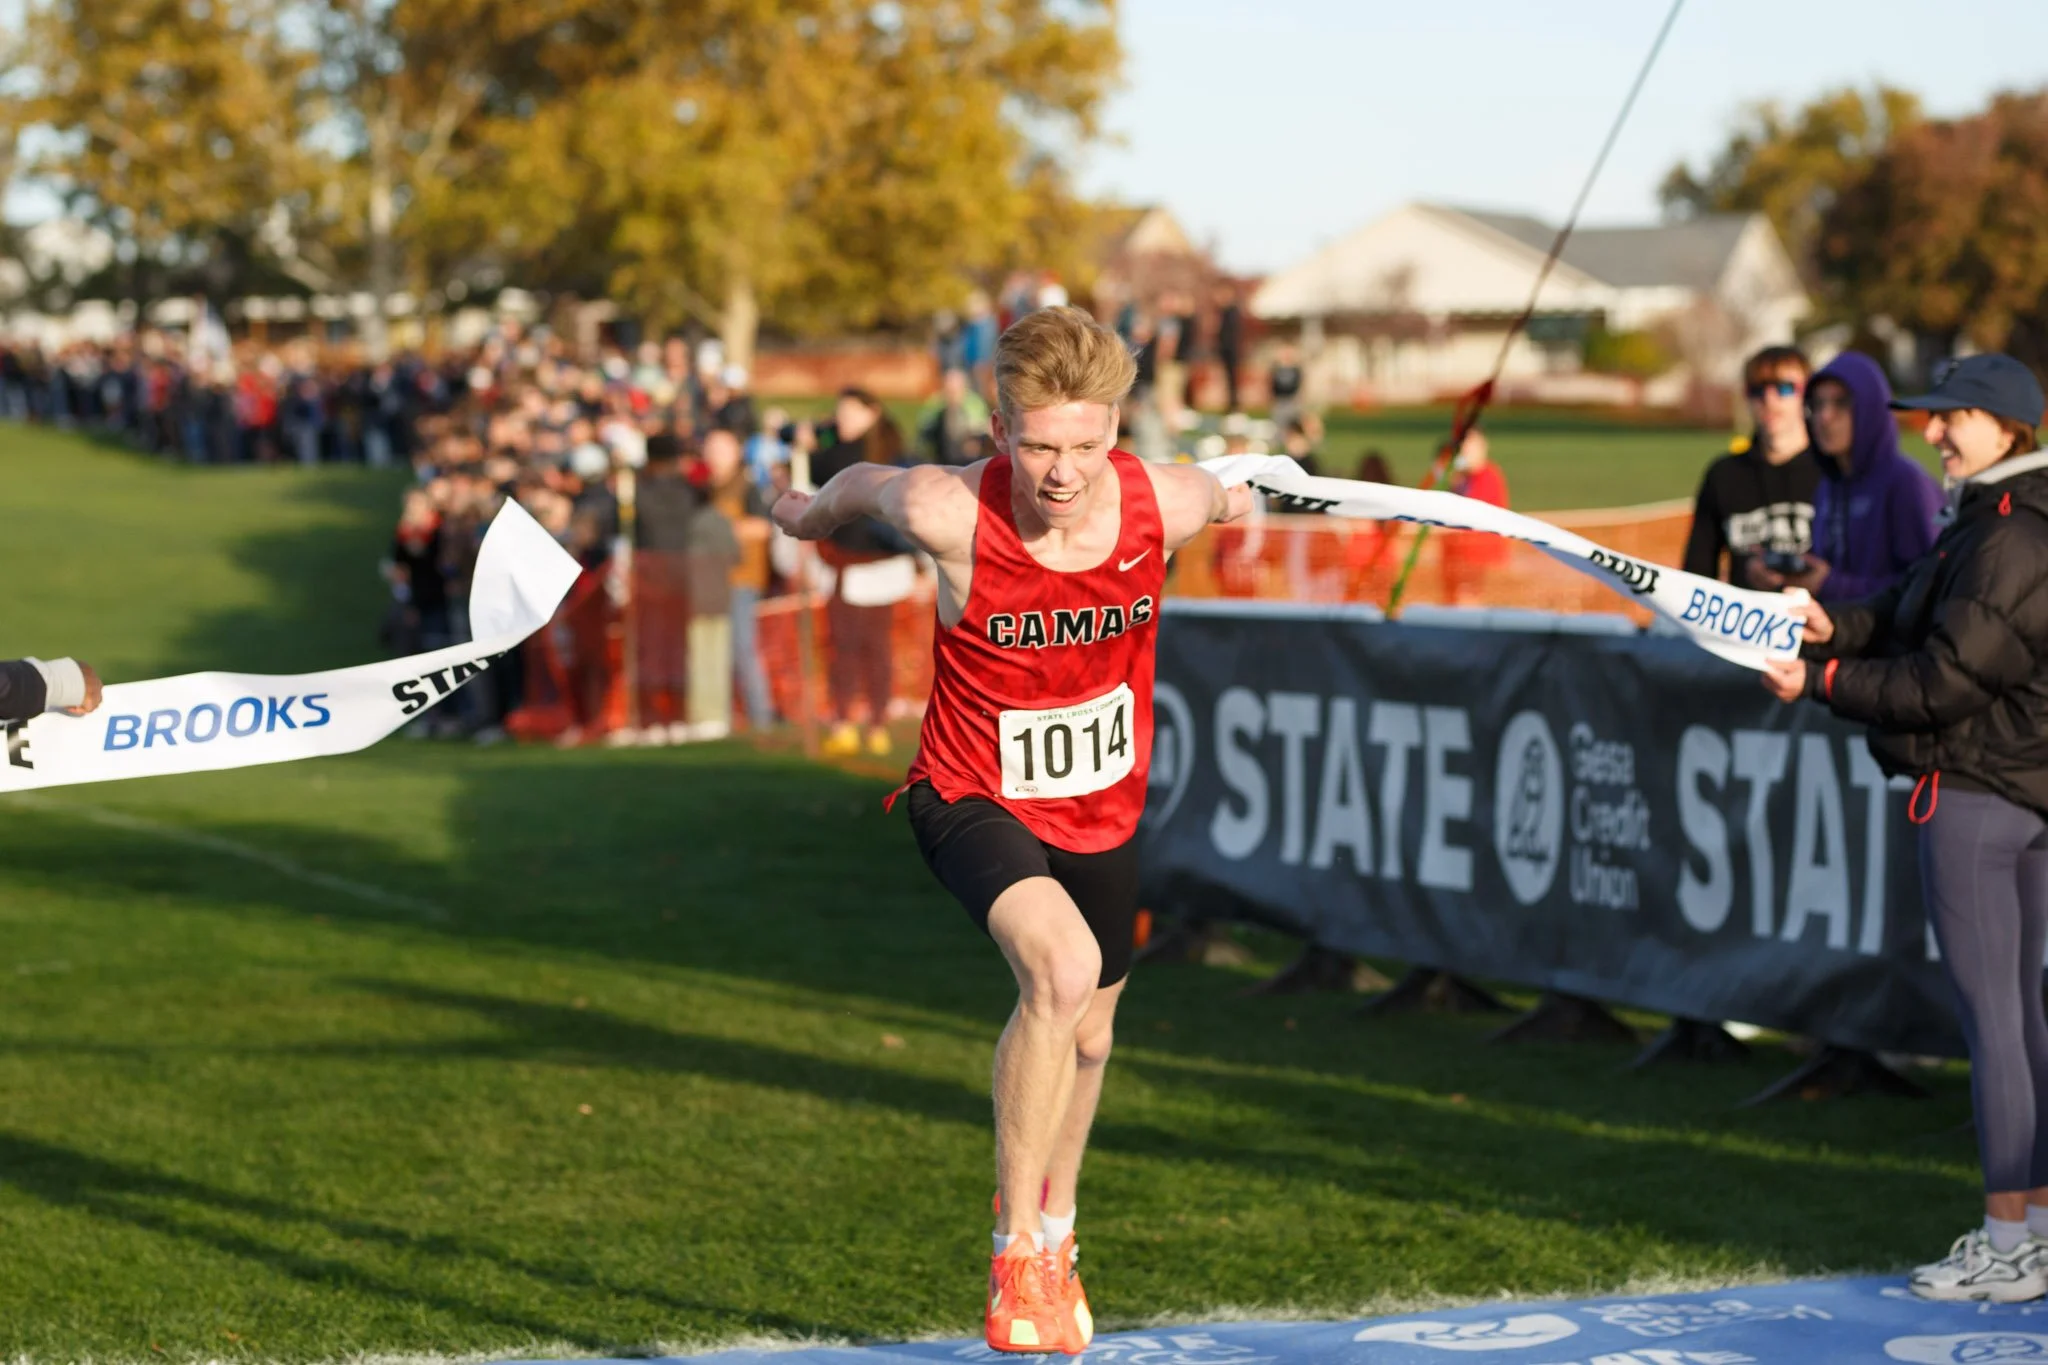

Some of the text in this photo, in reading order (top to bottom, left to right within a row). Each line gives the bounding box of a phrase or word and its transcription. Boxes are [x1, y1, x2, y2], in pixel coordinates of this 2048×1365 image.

[987, 594, 1154, 650] CAMAS
[1680, 588, 1804, 651] BROOKS
[392, 651, 503, 715] STA
[103, 693, 331, 752] BROOKS
[1013, 703, 1127, 781] 1014
[1036, 712, 1063, 722] STATE
[1210, 687, 1475, 892] STATE
[1676, 723, 1940, 961] STAT
